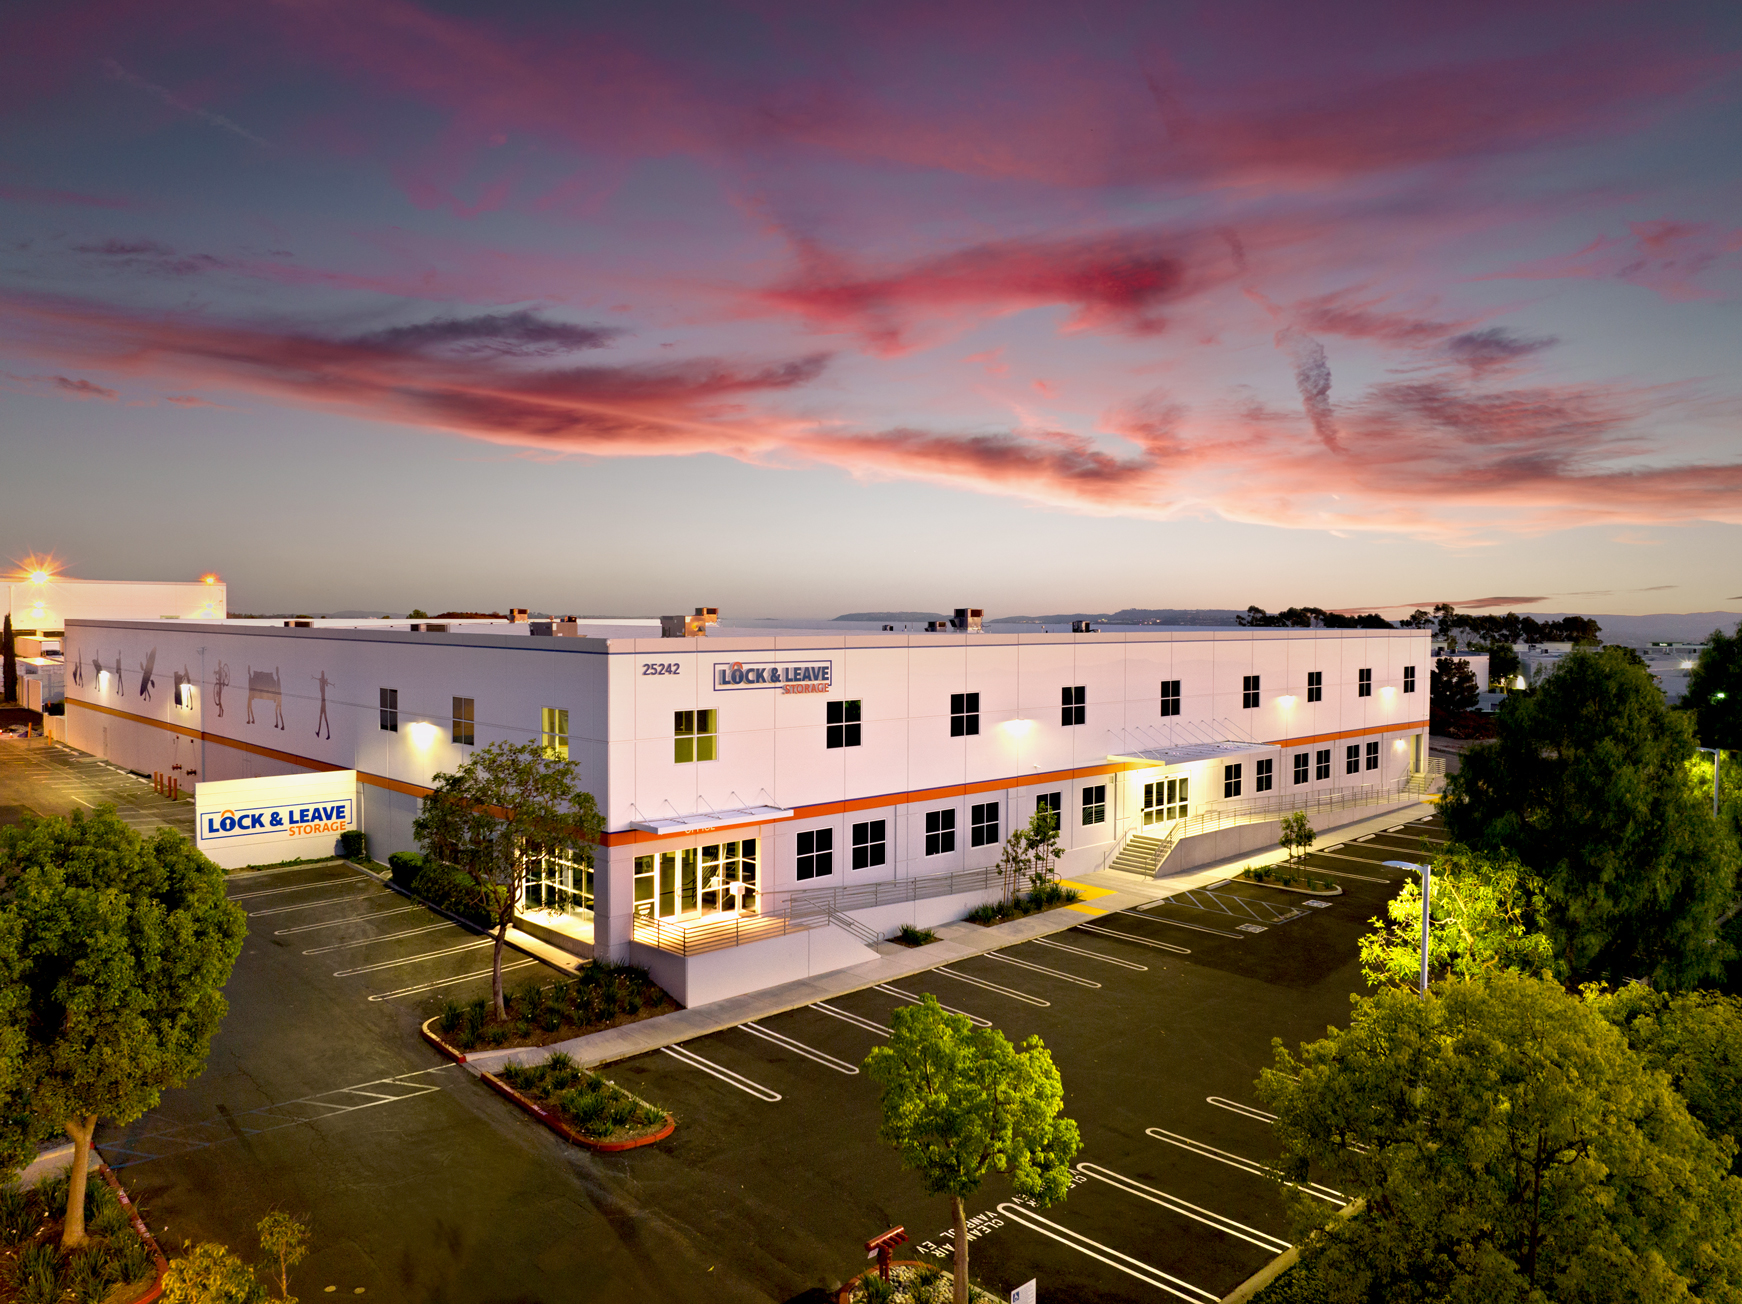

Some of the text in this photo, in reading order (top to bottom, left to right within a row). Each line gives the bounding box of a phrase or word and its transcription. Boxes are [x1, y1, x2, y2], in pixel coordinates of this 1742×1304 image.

[643, 663, 680, 676] 25242
[719, 662, 830, 685] LOCK & LEAVE
[783, 683, 830, 694] STORAGE
[208, 805, 346, 833] LOCK & LEAVE
[289, 821, 347, 836] STORAGE
[916, 1241, 937, 1254] EV
[931, 1243, 956, 1258] AIR
